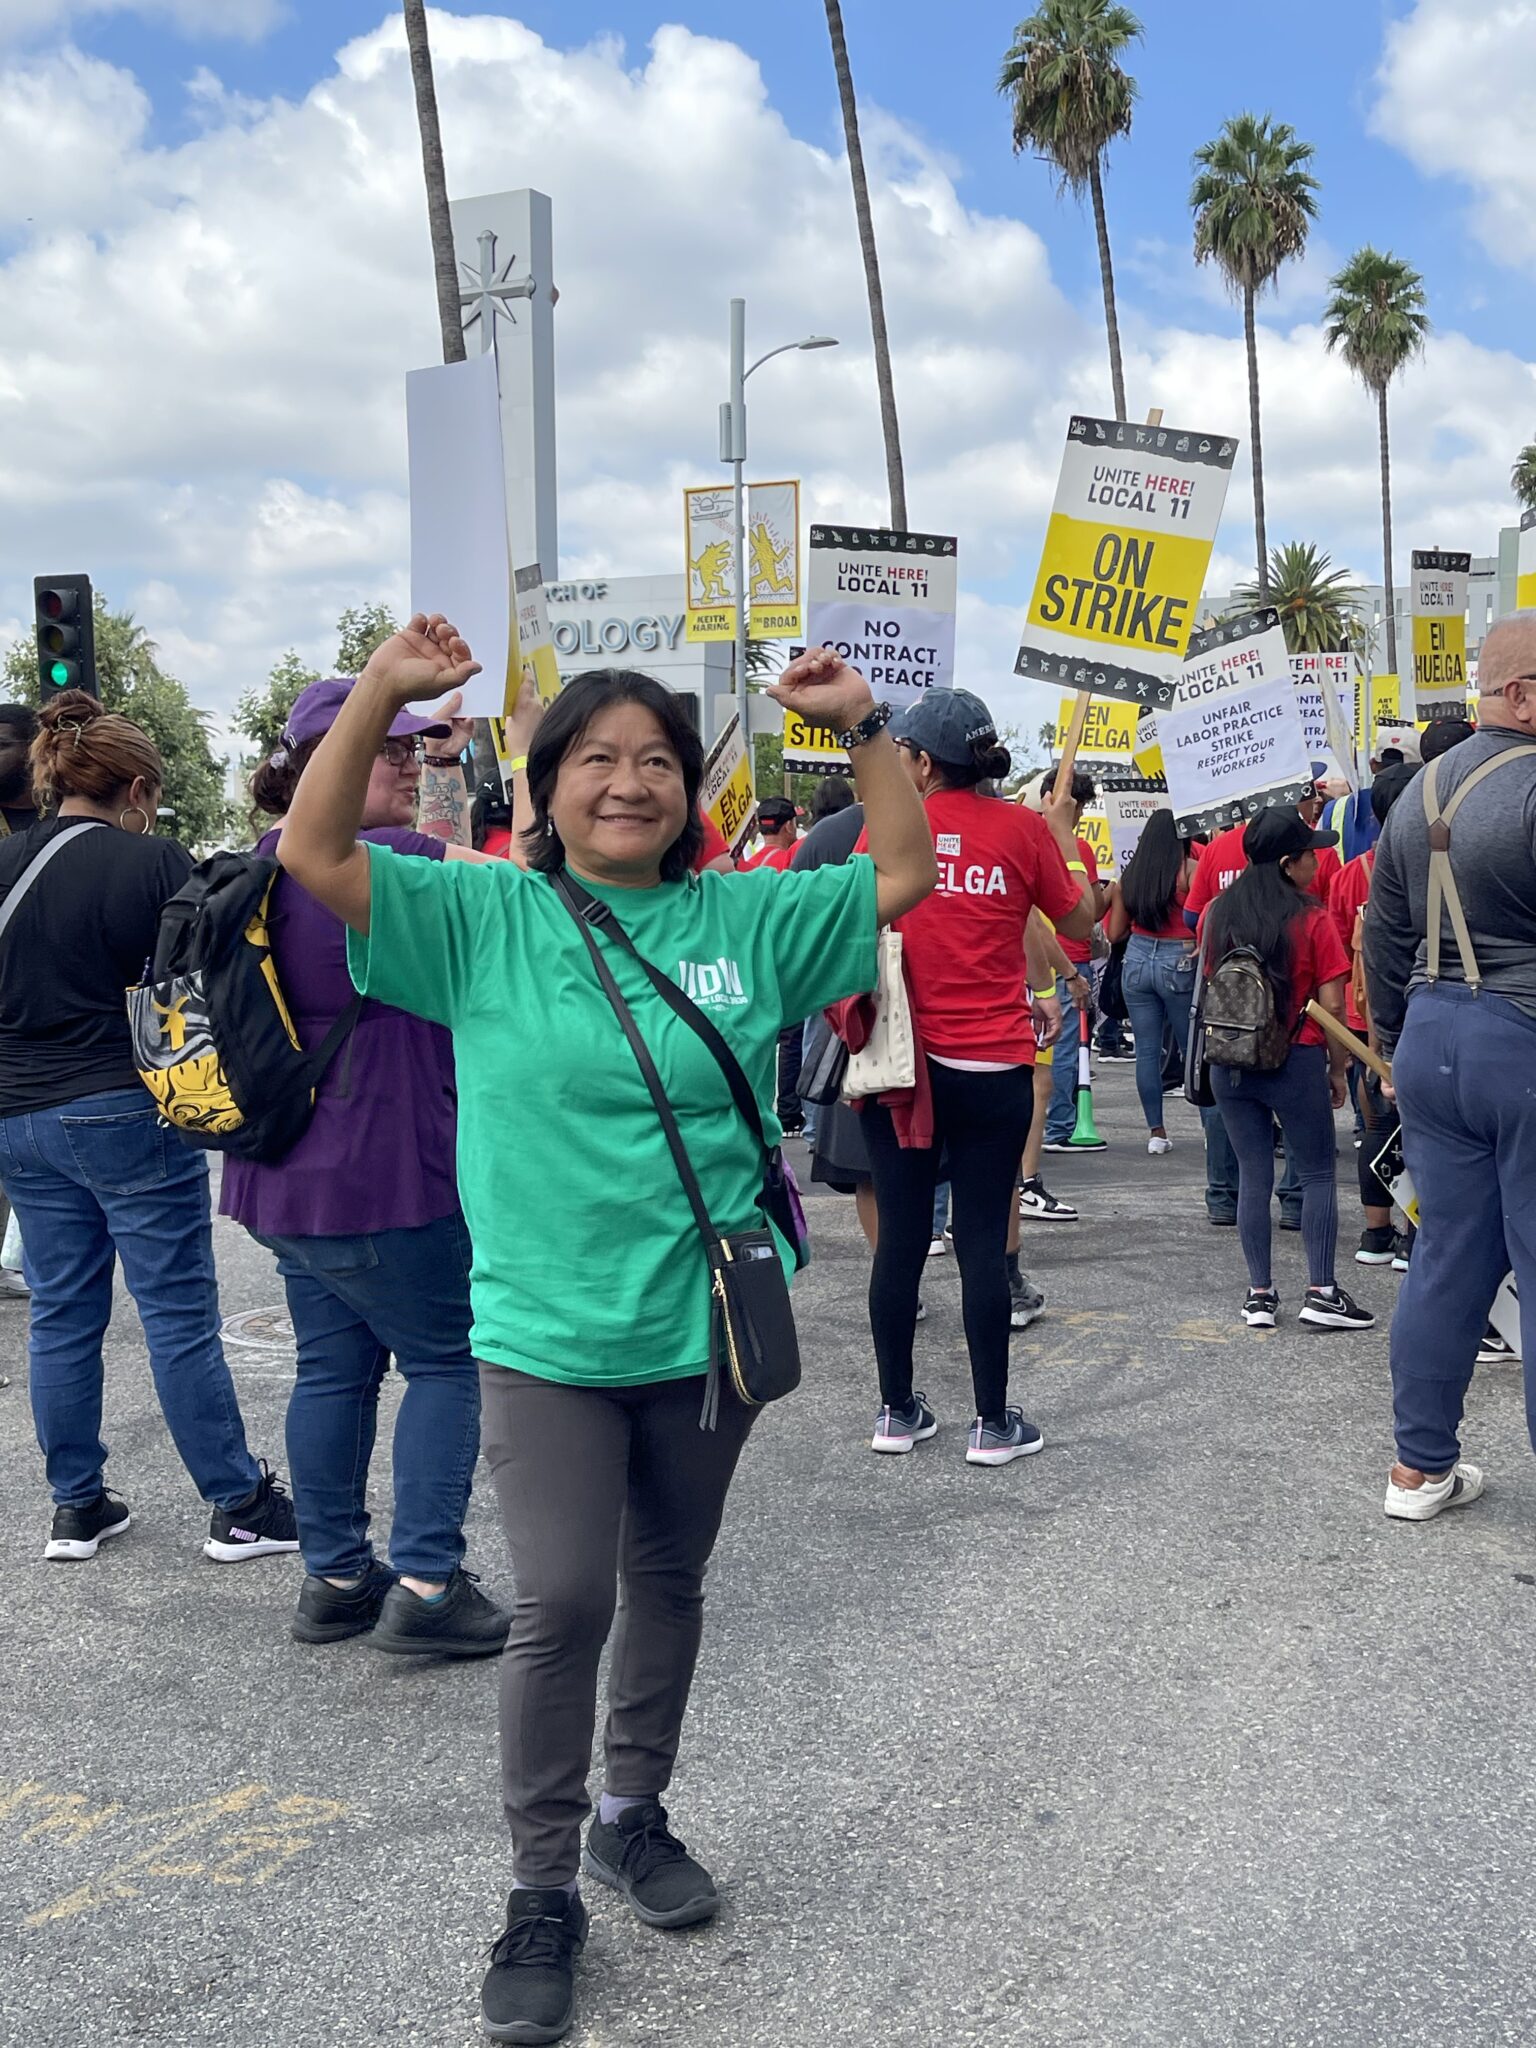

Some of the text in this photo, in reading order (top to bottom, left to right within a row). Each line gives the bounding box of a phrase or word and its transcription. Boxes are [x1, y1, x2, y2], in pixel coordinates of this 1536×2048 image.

[1093, 465, 1195, 497] UNITE HERE!
[1088, 483, 1191, 519] LOCAL 11
[838, 562, 928, 581] UNITE HERE!
[1093, 533, 1155, 588] ON
[837, 576, 928, 597] LOCAL 11
[1420, 581, 1439, 592] UNITE
[1420, 593, 1454, 606] LOCAL 11
[697, 614, 726, 623] KEITH
[763, 616, 798, 628] BROAD
[1040, 574, 1188, 648] STRIKE
[550, 614, 686, 655] OLOGY
[692, 623, 730, 631] HARING
[864, 620, 900, 638] NO
[1430, 622, 1446, 651] EN
[1221, 649, 1261, 671] HERE!
[1414, 654, 1463, 684] HUELGA
[871, 667, 935, 687] PEACE
[1178, 671, 1239, 702] LOCAL
[1246, 662, 1265, 679] 11
[1332, 672, 1348, 683] 11
[1085, 705, 1110, 726] EN
[1202, 701, 1252, 725] UNFAIR
[1058, 726, 1130, 749] HELGA
[1176, 705, 1284, 748] LABOR PRACTICE
[1211, 730, 1254, 752] STRIKE
[1197, 737, 1275, 770] RESPECT YOUR
[1211, 753, 1266, 778] WORKERS
[720, 782, 737, 818] EN
[1119, 800, 1139, 808] UNITE
[1120, 809, 1149, 819] LOCAL
[934, 862, 1008, 895] ELGA
[229, 1526, 258, 1542] PUMA
